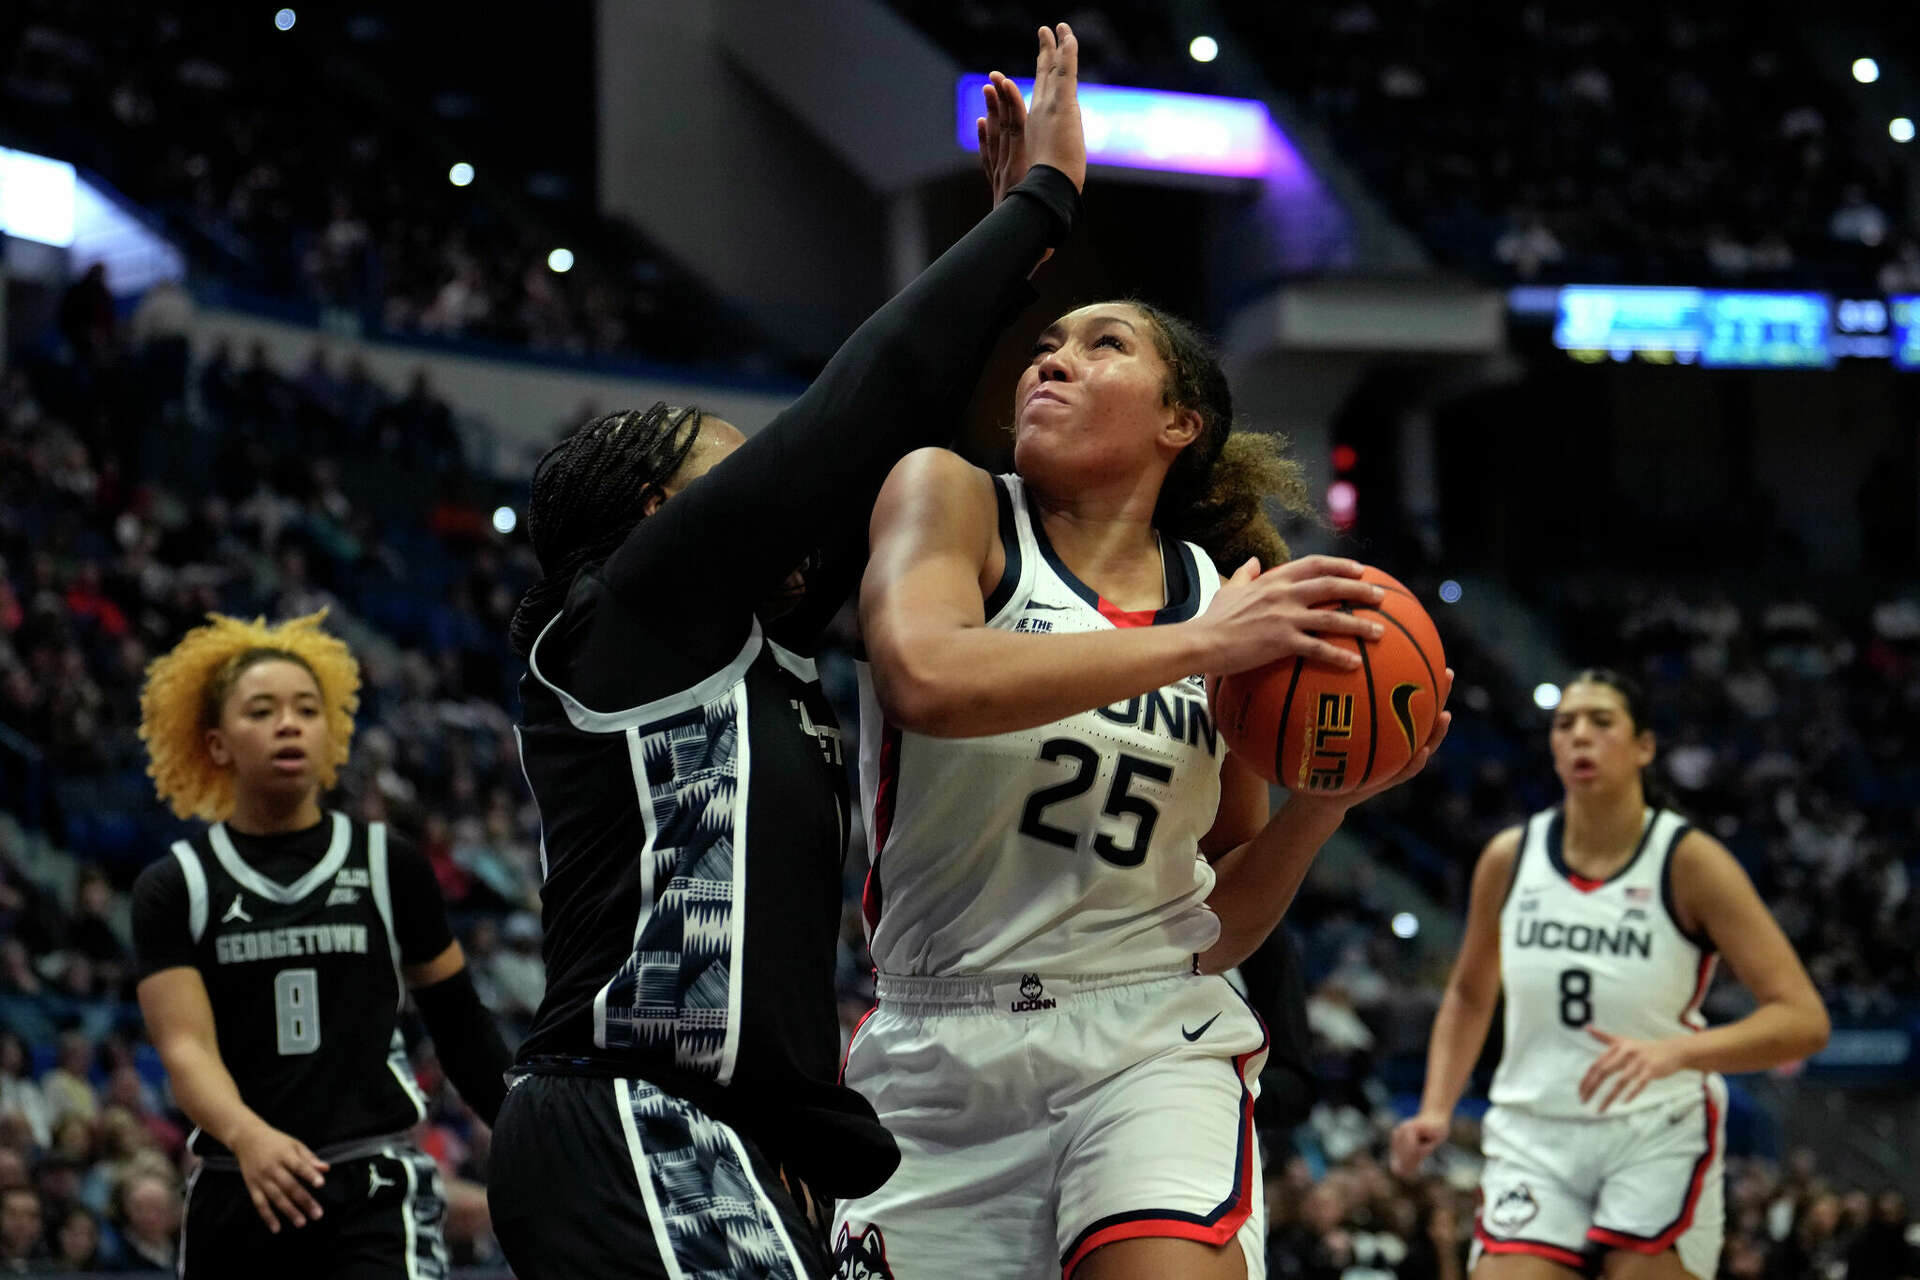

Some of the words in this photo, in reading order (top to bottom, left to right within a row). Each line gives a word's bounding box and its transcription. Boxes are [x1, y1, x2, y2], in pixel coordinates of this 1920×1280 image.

[1032, 618, 1053, 631] THE
[1095, 688, 1217, 758] ONN
[1308, 692, 1354, 791] ELITE
[1018, 735, 1175, 869] 25
[215, 924, 368, 964] GEORGETOWN
[1515, 918, 1652, 959] UCONN
[274, 967, 321, 1056] 8
[1011, 998, 1057, 1012] UCONN
[1558, 968, 1593, 1029] 8
